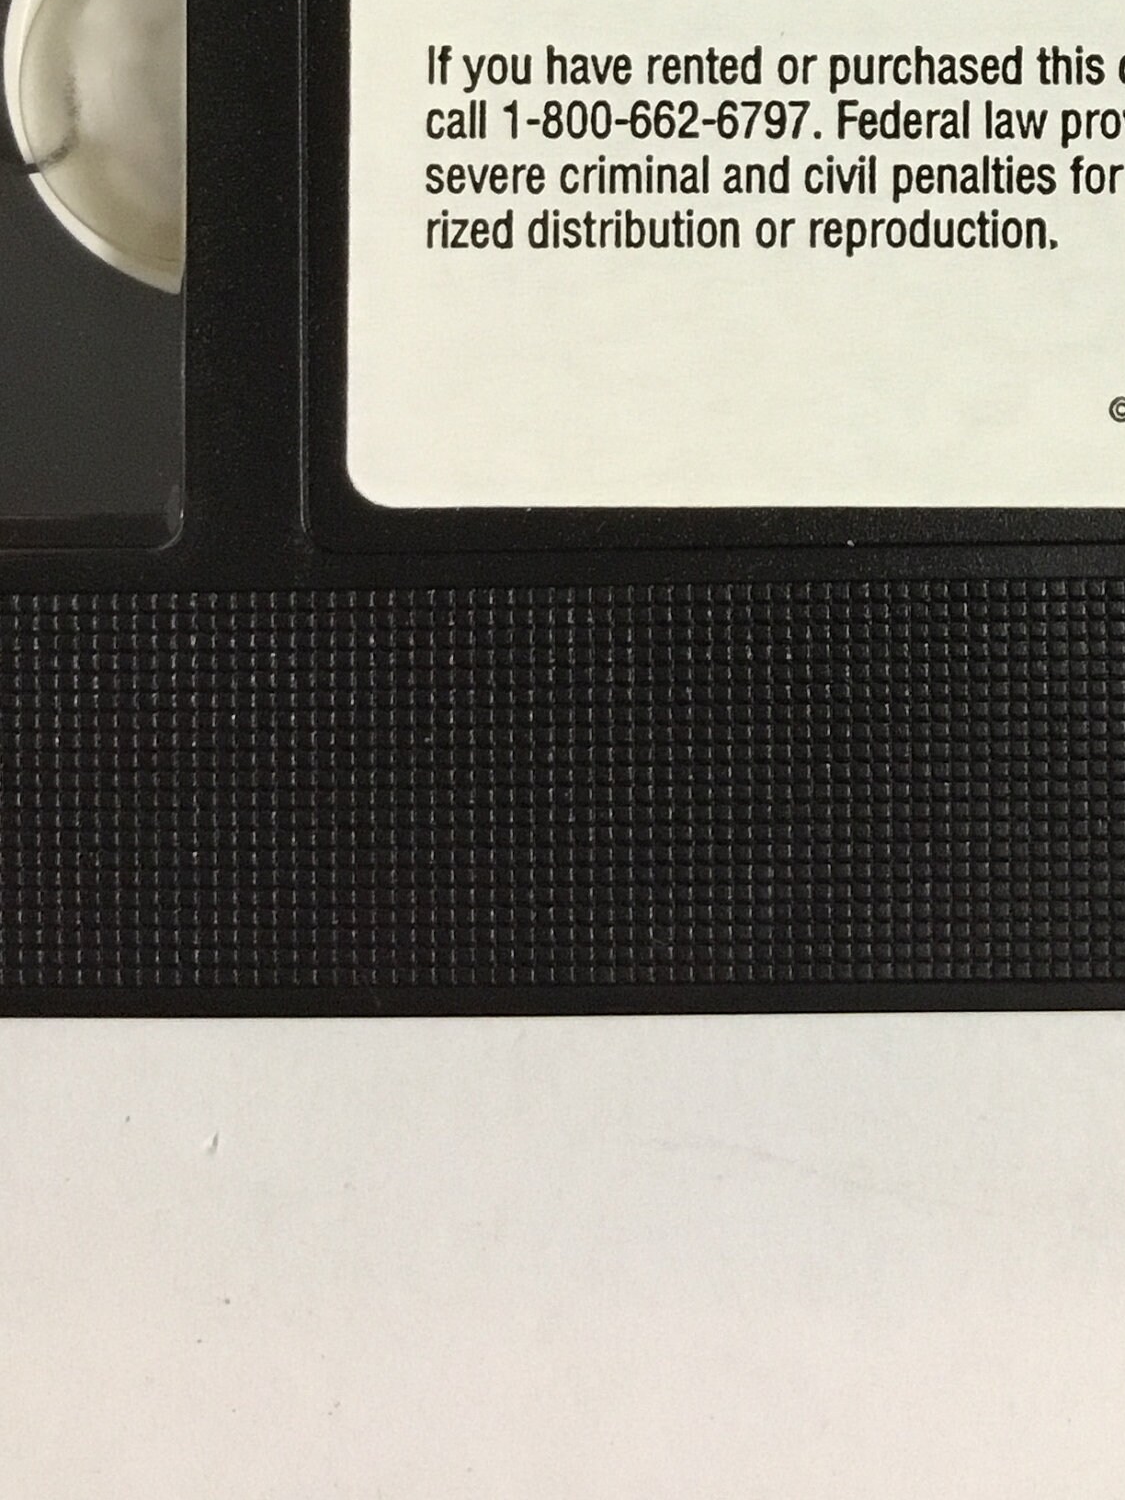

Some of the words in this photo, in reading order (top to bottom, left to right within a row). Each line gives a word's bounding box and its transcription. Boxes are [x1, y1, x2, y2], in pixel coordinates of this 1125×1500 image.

[428, 45, 452, 85] If
[463, 54, 532, 93] you
[547, 45, 632, 85] have
[647, 45, 762, 85] rented
[777, 54, 818, 85] or
[829, 45, 1023, 94] purchased
[1036, 45, 1105, 86] this
[426, 100, 487, 140] call
[503, 99, 822, 140] 1-800-662-6797.
[837, 99, 970, 140] Federal
[985, 99, 1049, 140] law
[426, 163, 546, 195] severe
[560, 155, 709, 195] criminal
[723, 155, 790, 195] and
[804, 155, 877, 195] civil
[892, 155, 1057, 204] penalties
[1069, 155, 1125, 195] for
[427, 209, 513, 250] rized
[527, 208, 740, 249] distribution
[755, 217, 796, 249] or
